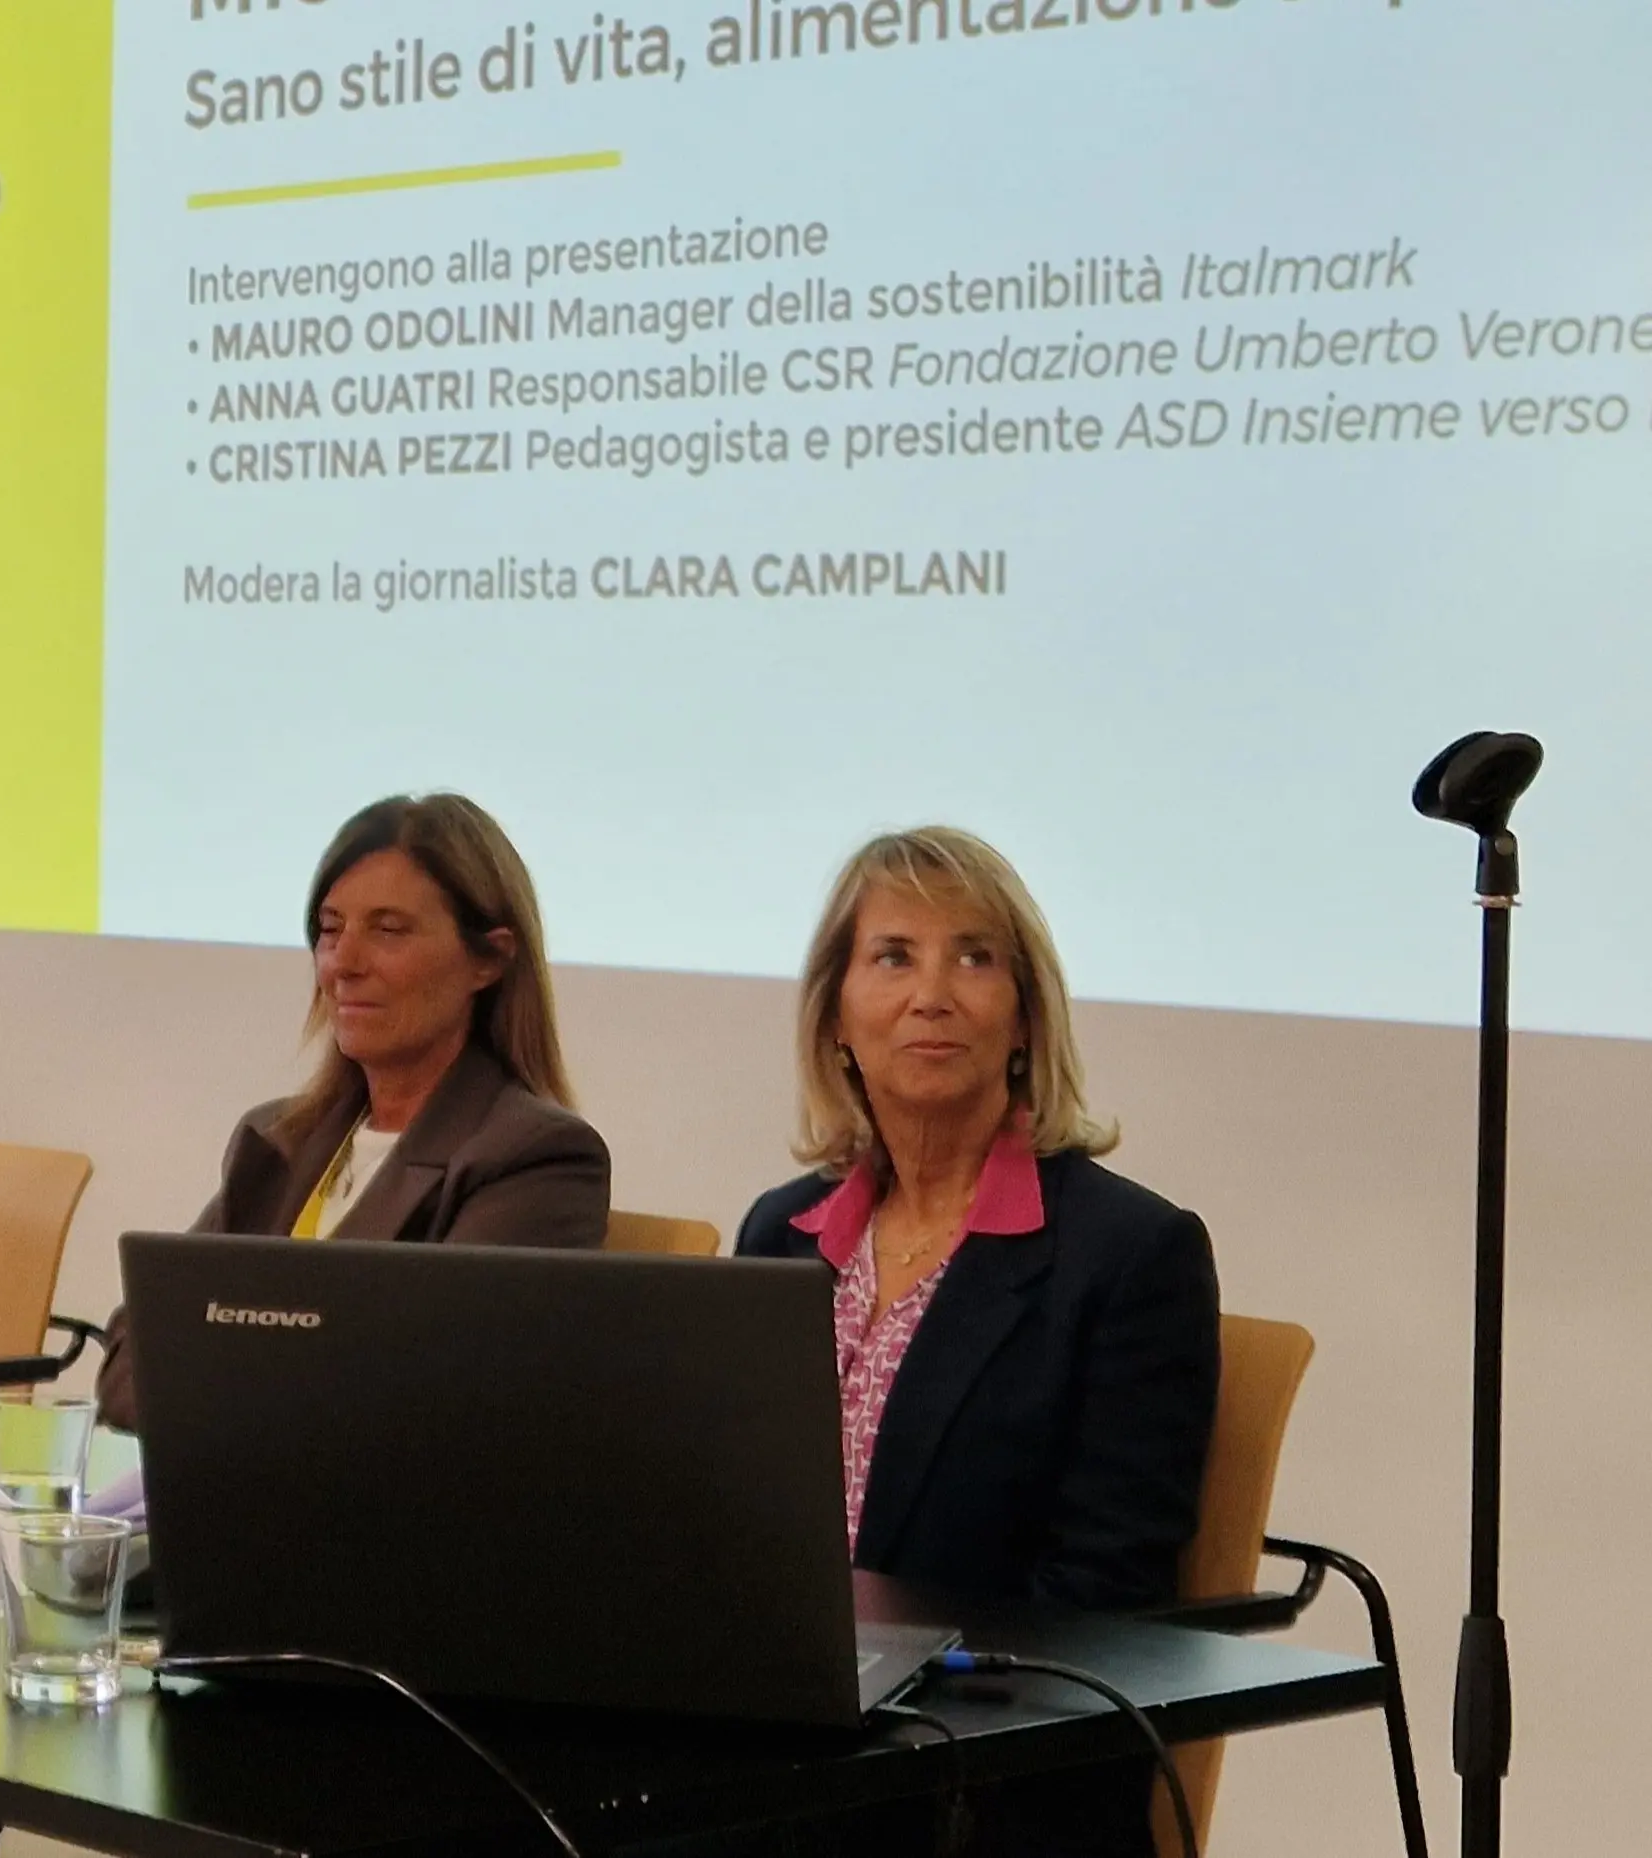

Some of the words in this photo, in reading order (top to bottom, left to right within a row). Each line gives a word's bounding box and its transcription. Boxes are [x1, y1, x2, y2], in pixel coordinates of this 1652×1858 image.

[185, 69, 324, 129] Sano
[339, 38, 462, 111] stile
[478, 21, 535, 94] di
[554, 13, 686, 83] vita,
[706, 0, 1242, 67] alimentaz
[188, 254, 435, 305] Intervengono
[446, 239, 512, 284] alla
[525, 216, 829, 287] presentazione
[212, 315, 354, 363] MAURO
[364, 301, 535, 352] ODOLINI
[548, 289, 734, 344] Manager
[747, 277, 853, 328] della
[867, 254, 1164, 319] sostenibilità
[1181, 236, 1419, 301] Italmark
[208, 379, 321, 423] ANNA
[331, 370, 475, 417] GUATRI
[488, 352, 768, 414] Responsabile
[781, 346, 874, 395] CSR
[888, 330, 1178, 389] Fondazione
[1195, 317, 1439, 374] Umberto
[1459, 309, 1652, 361] Verone
[208, 437, 387, 483] CRISTINA
[398, 433, 512, 476] PEZZI
[526, 419, 790, 478] Pedagogista
[803, 426, 829, 461] e
[844, 406, 1104, 469] presidente
[1115, 400, 1229, 451] ASD
[1243, 391, 1461, 446] Insieme
[1479, 394, 1630, 438] verso
[184, 559, 320, 605] Modera
[333, 561, 362, 602] la
[373, 556, 578, 613] giornalista
[590, 556, 740, 599] CLARA
[751, 550, 1007, 598] CAMPLANI
[205, 1301, 322, 1328] lenovo
